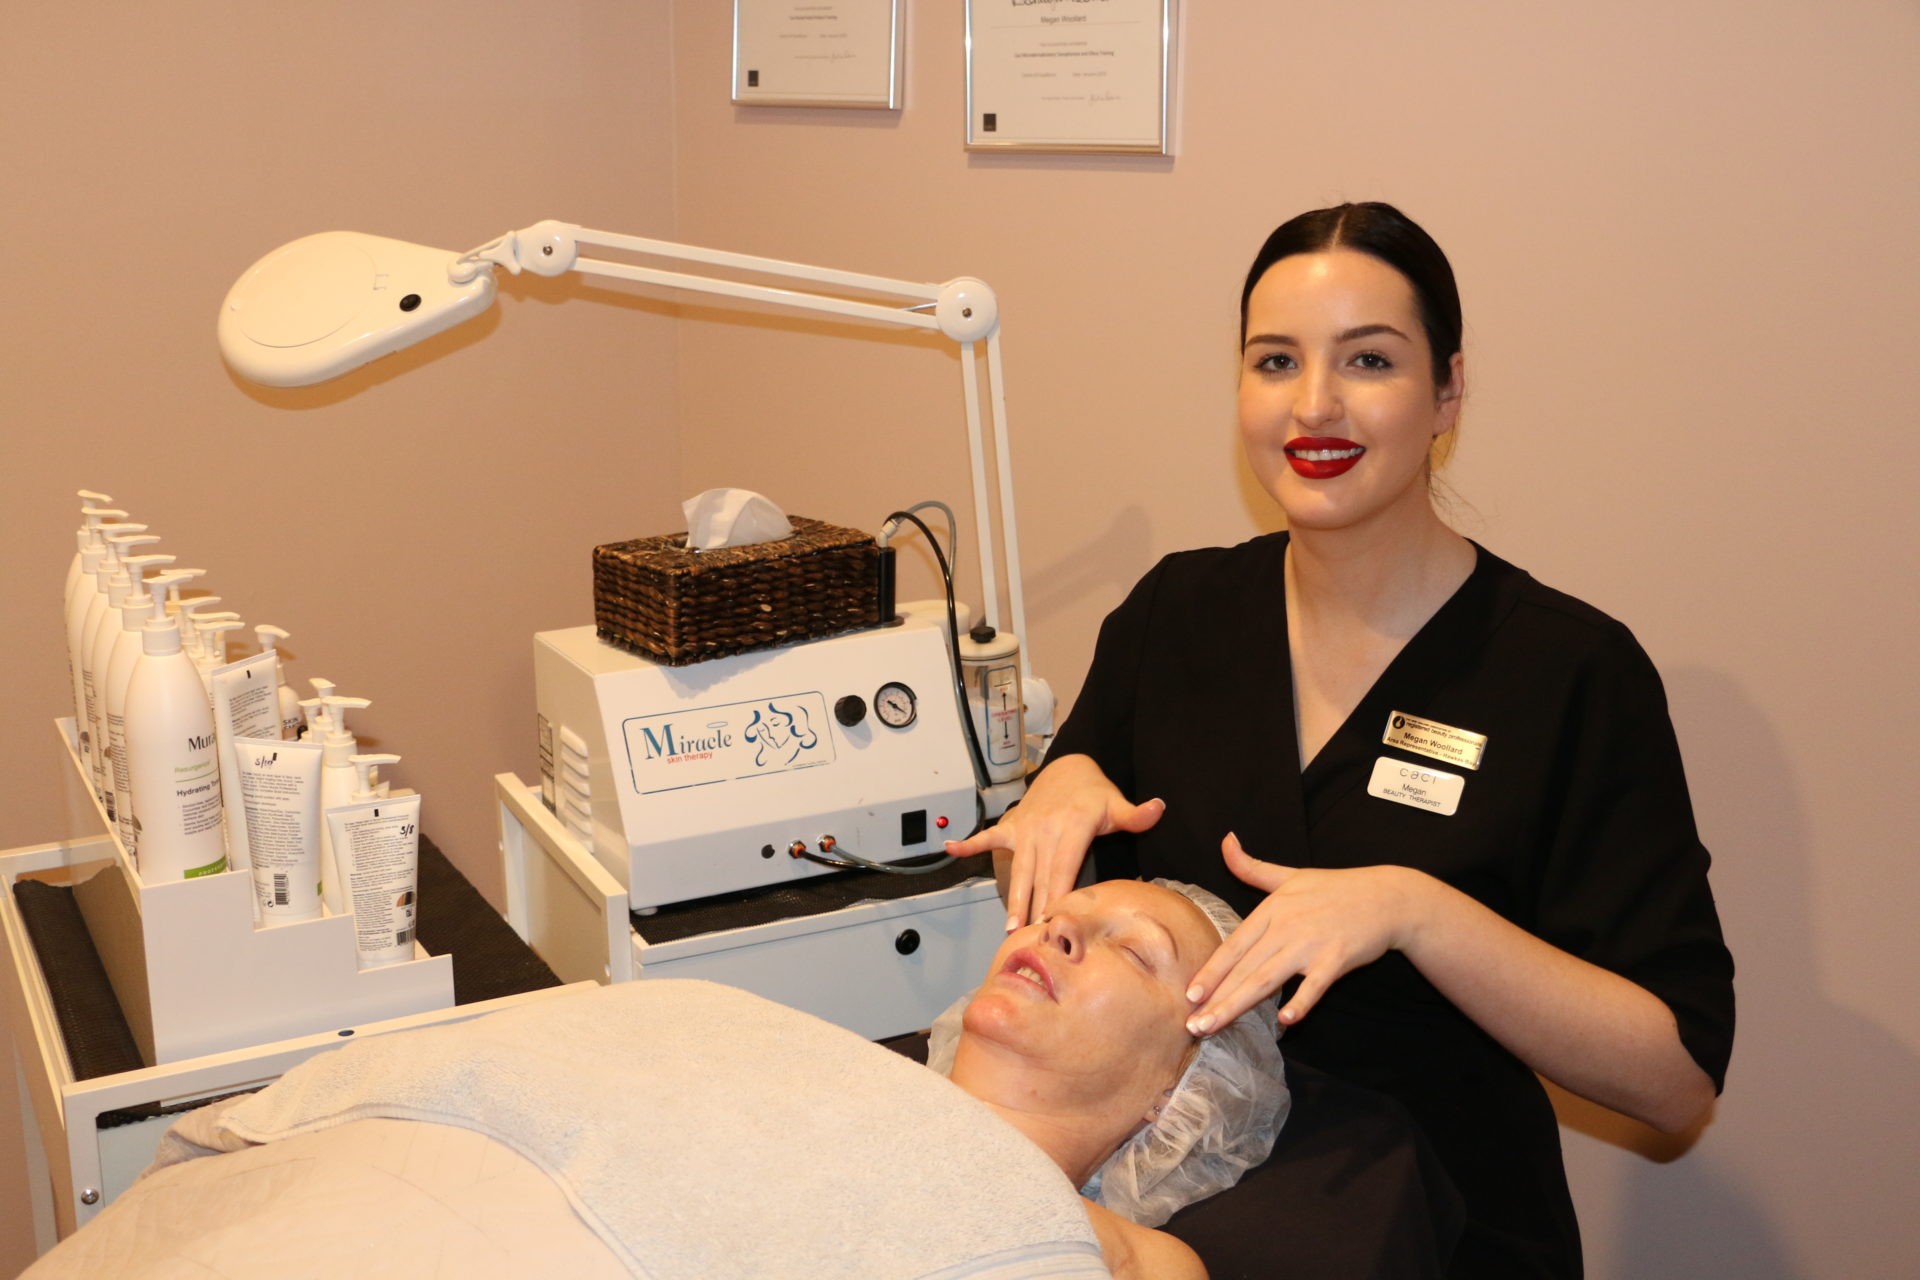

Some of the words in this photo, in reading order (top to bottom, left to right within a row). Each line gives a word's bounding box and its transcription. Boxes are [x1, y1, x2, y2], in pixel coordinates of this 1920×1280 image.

[640, 723, 732, 760] Miracle
[1431, 728, 1447, 738] beauty
[188, 733, 216, 752] Mura
[1386, 736, 1400, 745] Area
[1400, 740, 1438, 755] Representative
[1404, 732, 1428, 746] Megan
[1430, 739, 1463, 755] Woollard
[667, 756, 683, 764] skin
[684, 751, 713, 763] therapy
[1399, 768, 1437, 785] caci
[176, 783, 211, 798] Hydrating
[1383, 788, 1405, 798] BEAUTY
[1409, 794, 1441, 807] THERAPIST
[1402, 784, 1426, 796] Megan
